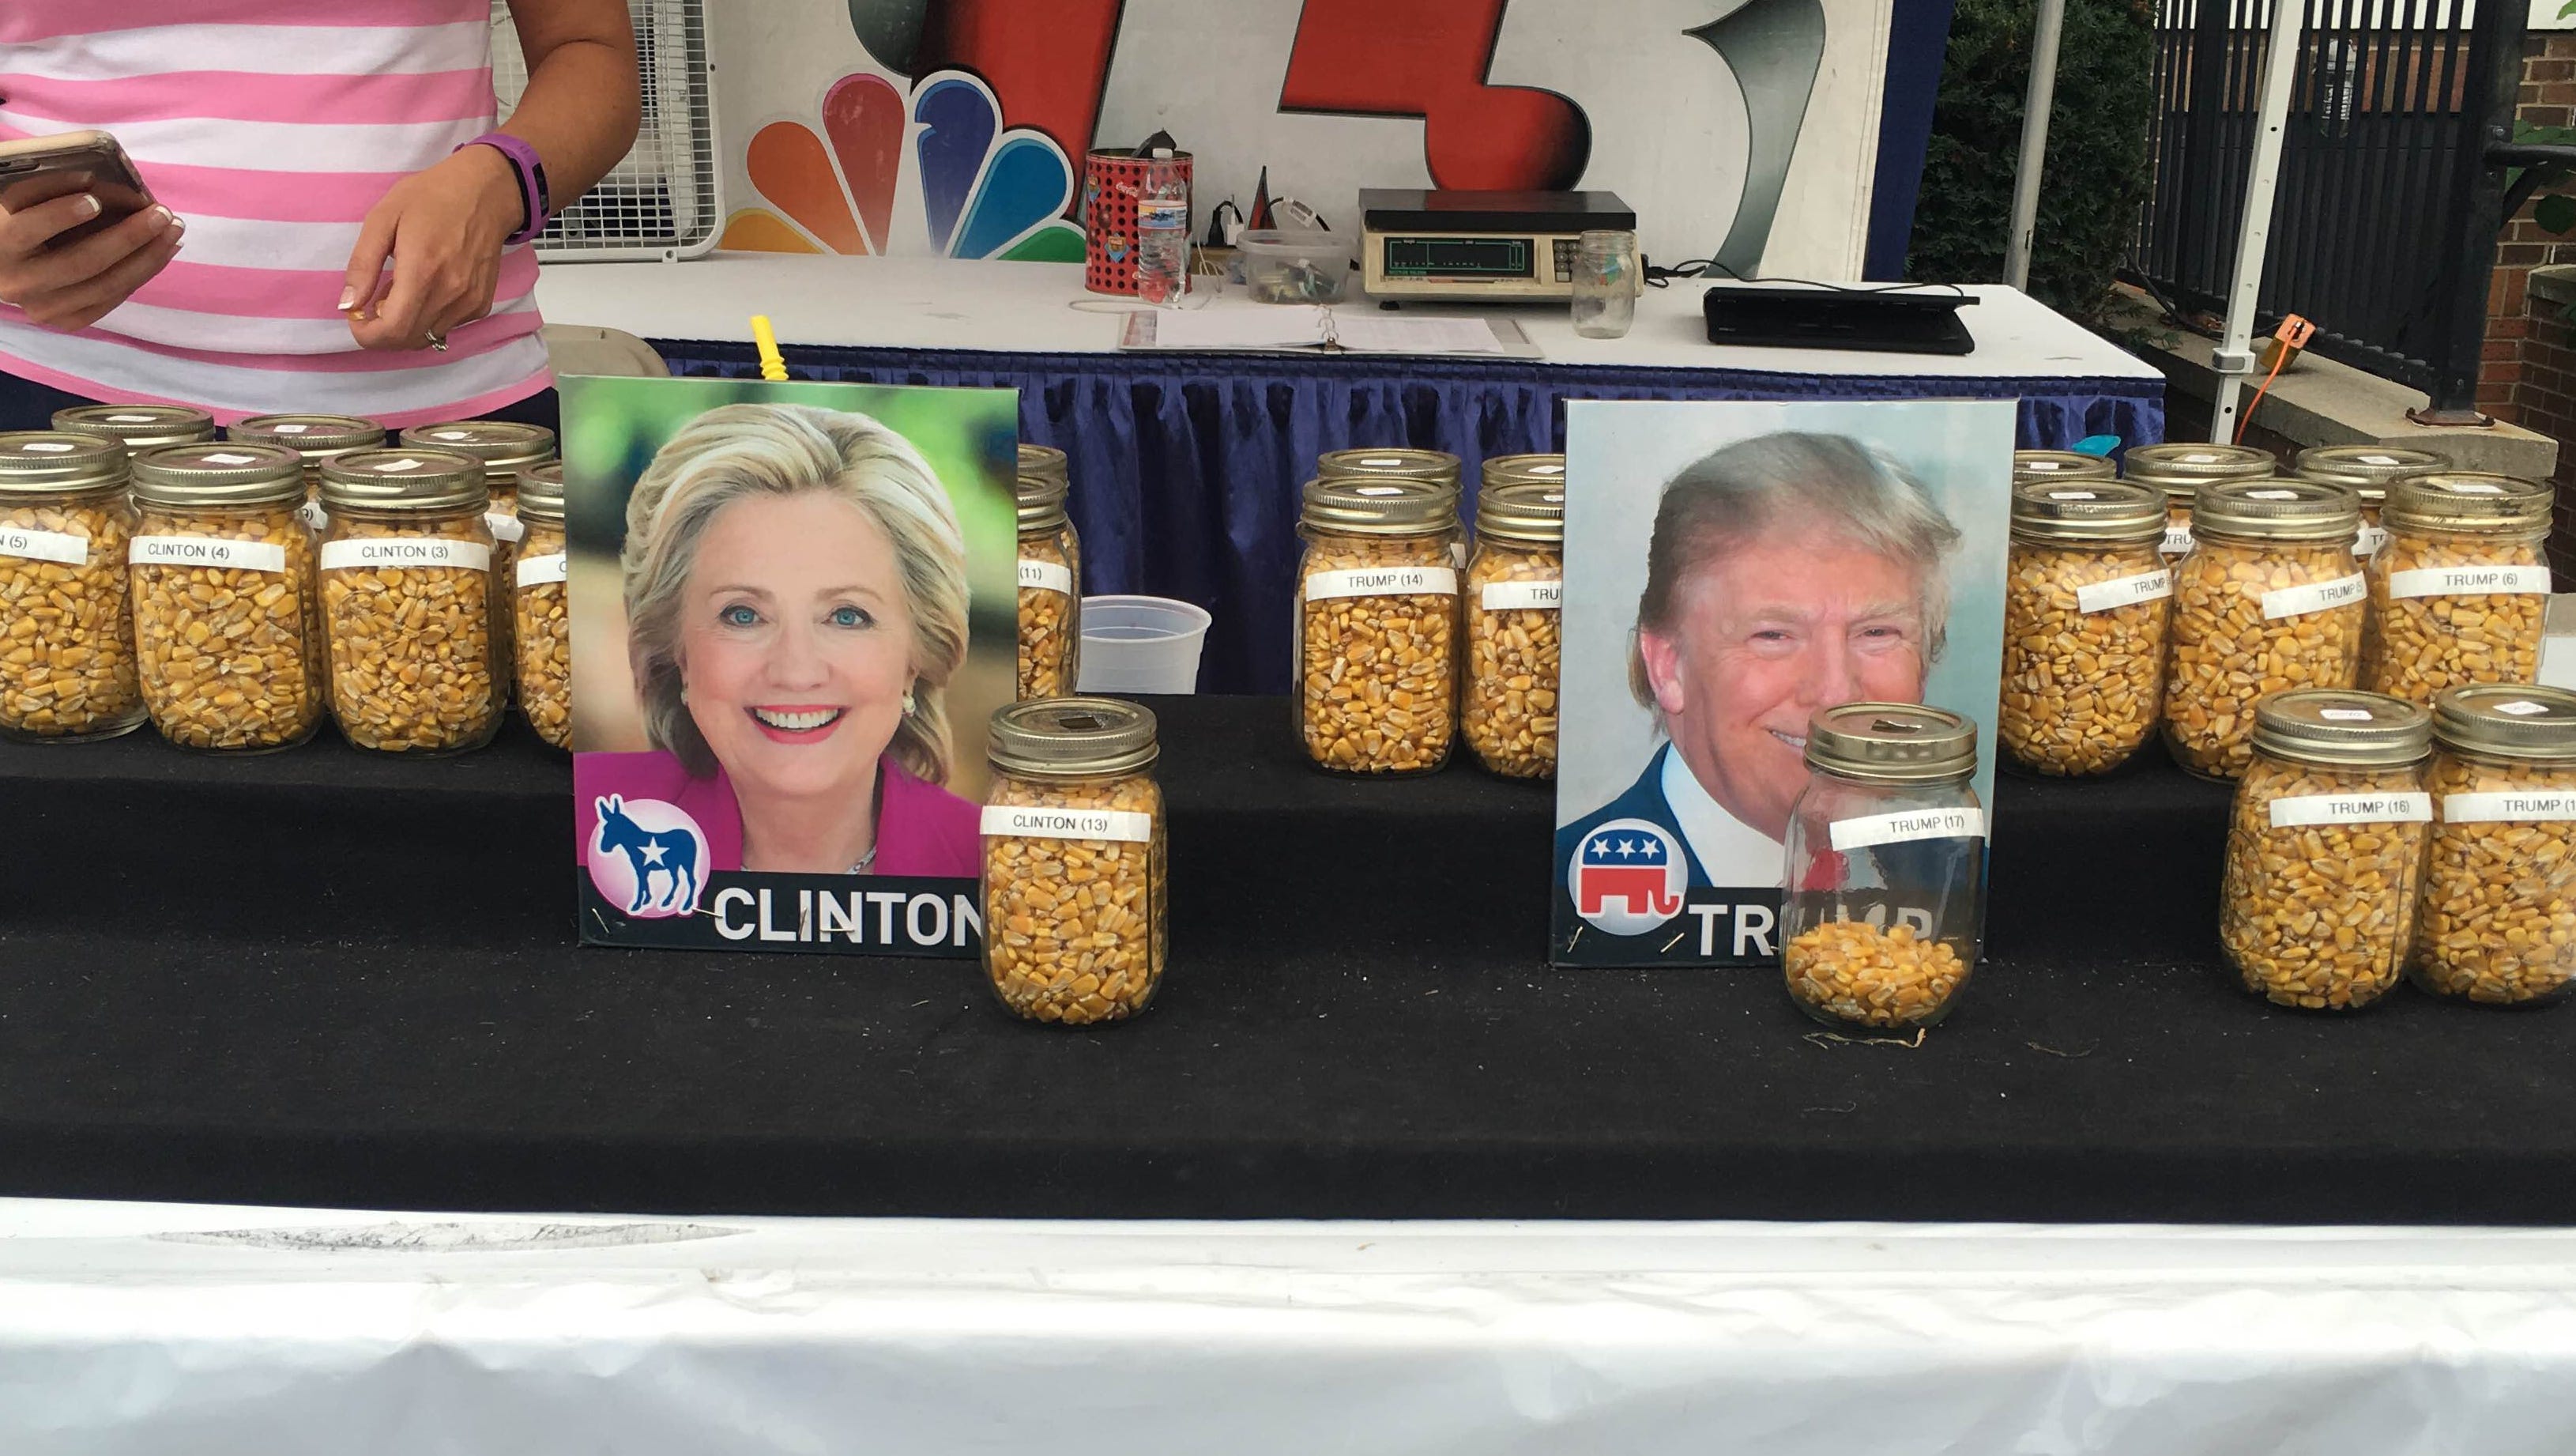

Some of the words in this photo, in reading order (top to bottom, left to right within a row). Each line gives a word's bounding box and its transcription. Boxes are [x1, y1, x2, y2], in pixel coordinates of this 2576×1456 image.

[9, 536, 27, 550] (5)
[148, 544, 205, 557] CLINTON
[211, 545, 230, 560] (4)
[362, 545, 426, 558] CLINTON
[431, 545, 448, 560] (3)
[1019, 566, 1041, 581] (11)
[1347, 574, 1396, 587] TRUMP
[1401, 574, 1423, 587] (14)
[2444, 573, 2498, 586] TRUMP
[2503, 572, 2518, 586] (6)
[2131, 577, 2165, 594] TRUMP
[2318, 583, 2356, 601] TRUMP
[1530, 588, 1562, 600] TRU
[2329, 801, 2384, 815] TRUMP
[2388, 800, 2409, 814] (16)
[2503, 799, 2561, 813] TRUMP
[2564, 799, 2576, 813] (1
[1012, 814, 1075, 829] CLINTON
[1081, 817, 1108, 832] (13)
[1889, 817, 1941, 833] TRUMP
[1945, 815, 1964, 829] (17)
[714, 887, 981, 947] CLINTON
